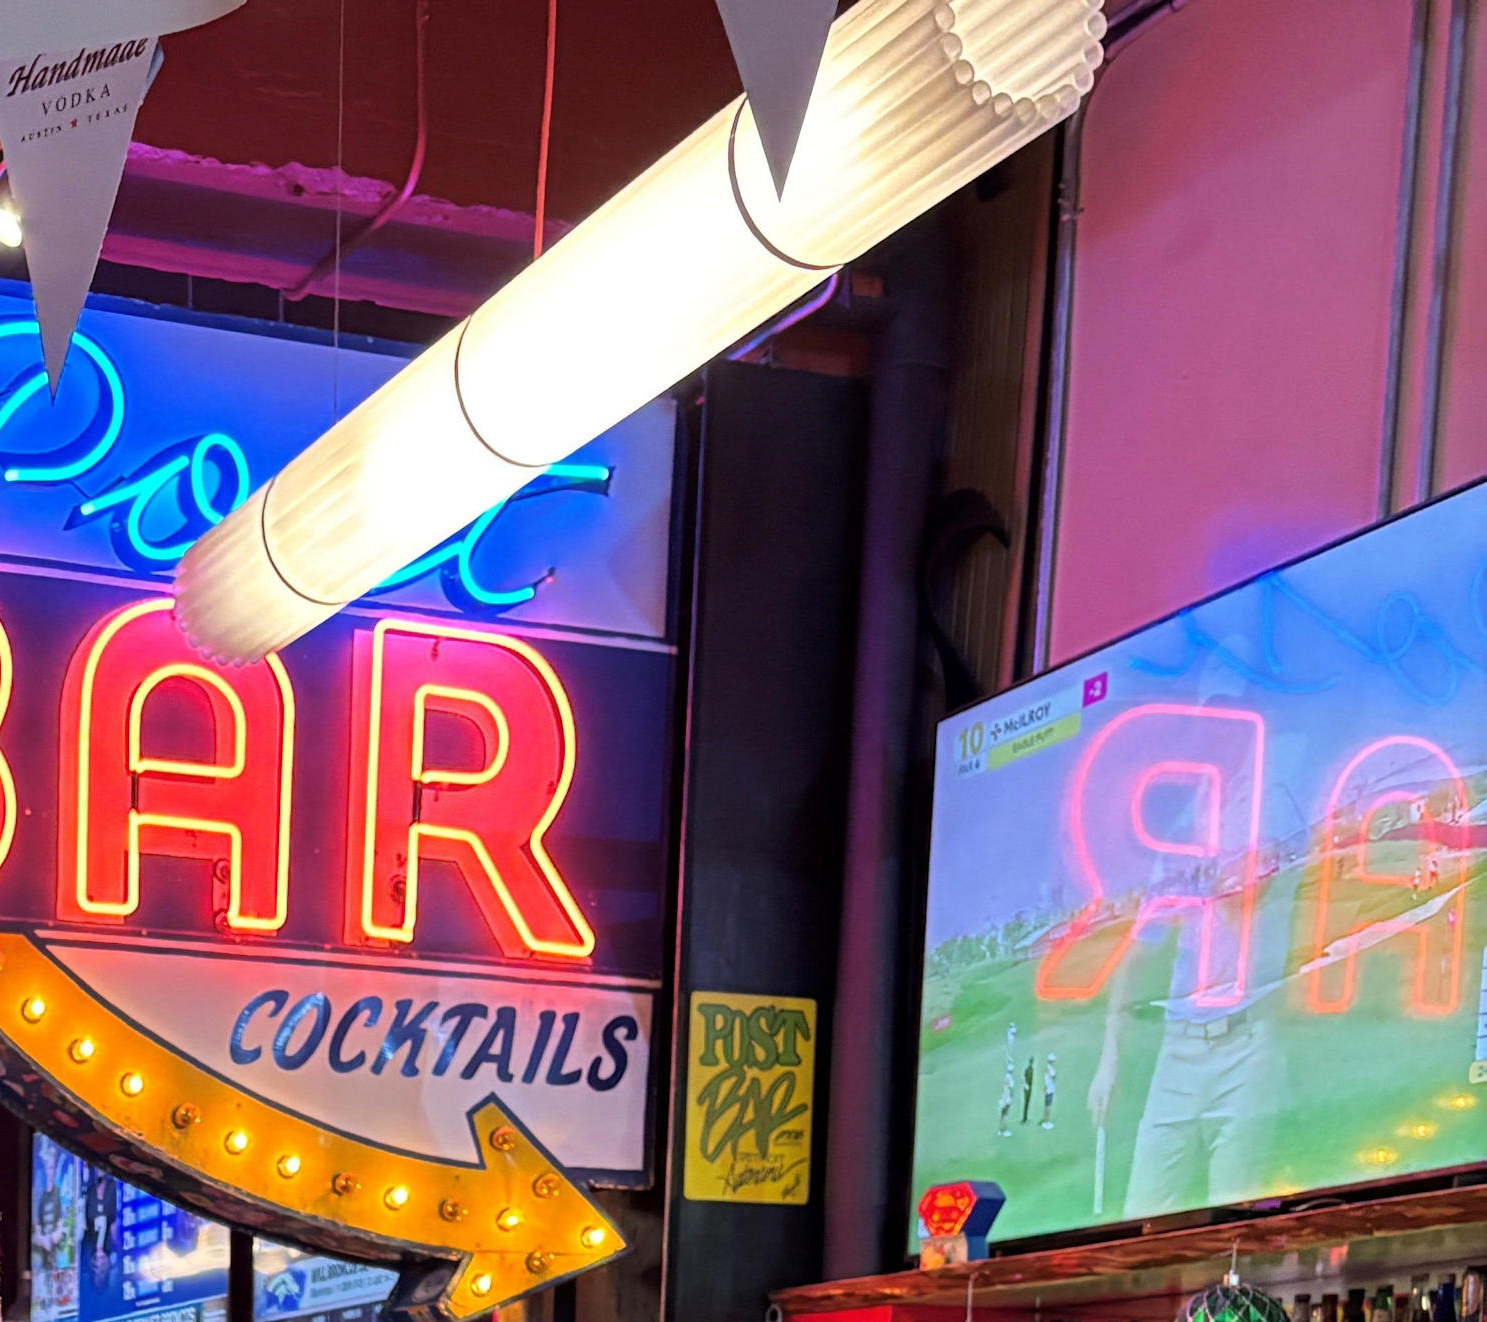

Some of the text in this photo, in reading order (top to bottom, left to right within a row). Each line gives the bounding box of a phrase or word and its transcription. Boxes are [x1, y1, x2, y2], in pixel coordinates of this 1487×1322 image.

[41, 83, 111, 116] VODKA
[88, 103, 129, 123] TEXAS
[958, 721, 984, 760] 10
[227, 990, 641, 1091] COCKTAILS
[697, 1002, 811, 1071] POST
[696, 1065, 810, 1165] BAR
